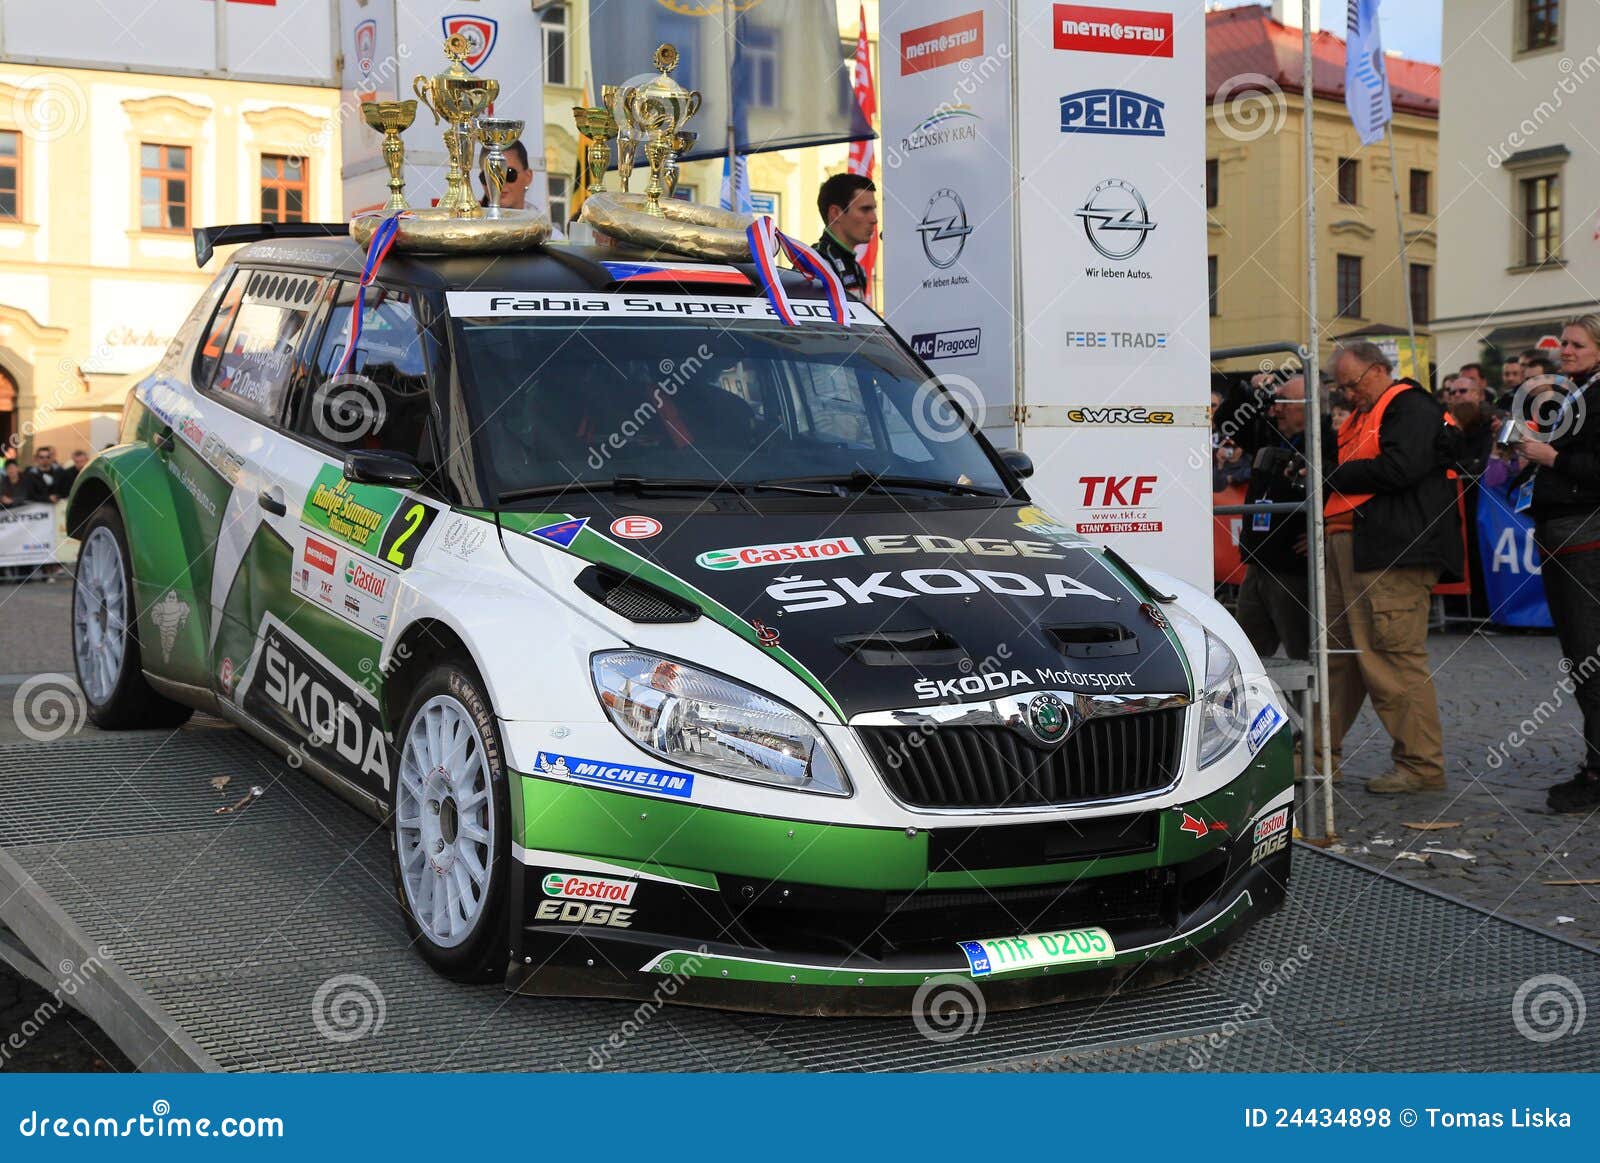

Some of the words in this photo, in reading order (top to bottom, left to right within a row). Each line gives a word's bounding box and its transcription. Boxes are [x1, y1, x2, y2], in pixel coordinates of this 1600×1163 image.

[1060, 93, 1164, 130] PETRA
[922, 279, 932, 289] Wir
[933, 277, 950, 288] leben
[1085, 267, 1100, 279] Wir
[1101, 267, 1126, 279] leben
[1127, 269, 1153, 280] Autos.
[489, 297, 609, 313] Fabia
[623, 299, 752, 316] Super
[765, 303, 857, 319] 200
[913, 340, 934, 355] AAC
[937, 334, 978, 354] Pragocel
[1065, 330, 1106, 348] FEBE
[1111, 331, 1167, 349] TRADE
[1078, 476, 1158, 507] TKF
[1080, 523, 1105, 533] STANY
[1110, 523, 1135, 532] TENTS
[1137, 522, 1159, 532] ZELTE
[1092, 510, 1147, 520] www.tkf.cz
[386, 504, 425, 566] 2
[739, 538, 855, 564] Castrol
[863, 534, 1067, 560] EDGE
[321, 580, 333, 594] TKF
[353, 564, 386, 598] Castrol
[766, 567, 1118, 614] ŠKODA
[913, 669, 1035, 700] ŠKODA
[1036, 667, 1137, 692] Motorsport
[264, 635, 391, 792] ŠKODA
[573, 762, 688, 790] MICHELIN
[1260, 815, 1285, 839] Castrol
[1251, 829, 1289, 866] EDGE
[563, 876, 631, 902] Castrol
[534, 899, 638, 928] EDGE
[973, 960, 989, 972] CZ
[986, 936, 1034, 964] 11R
[1038, 928, 1109, 957] 0205
